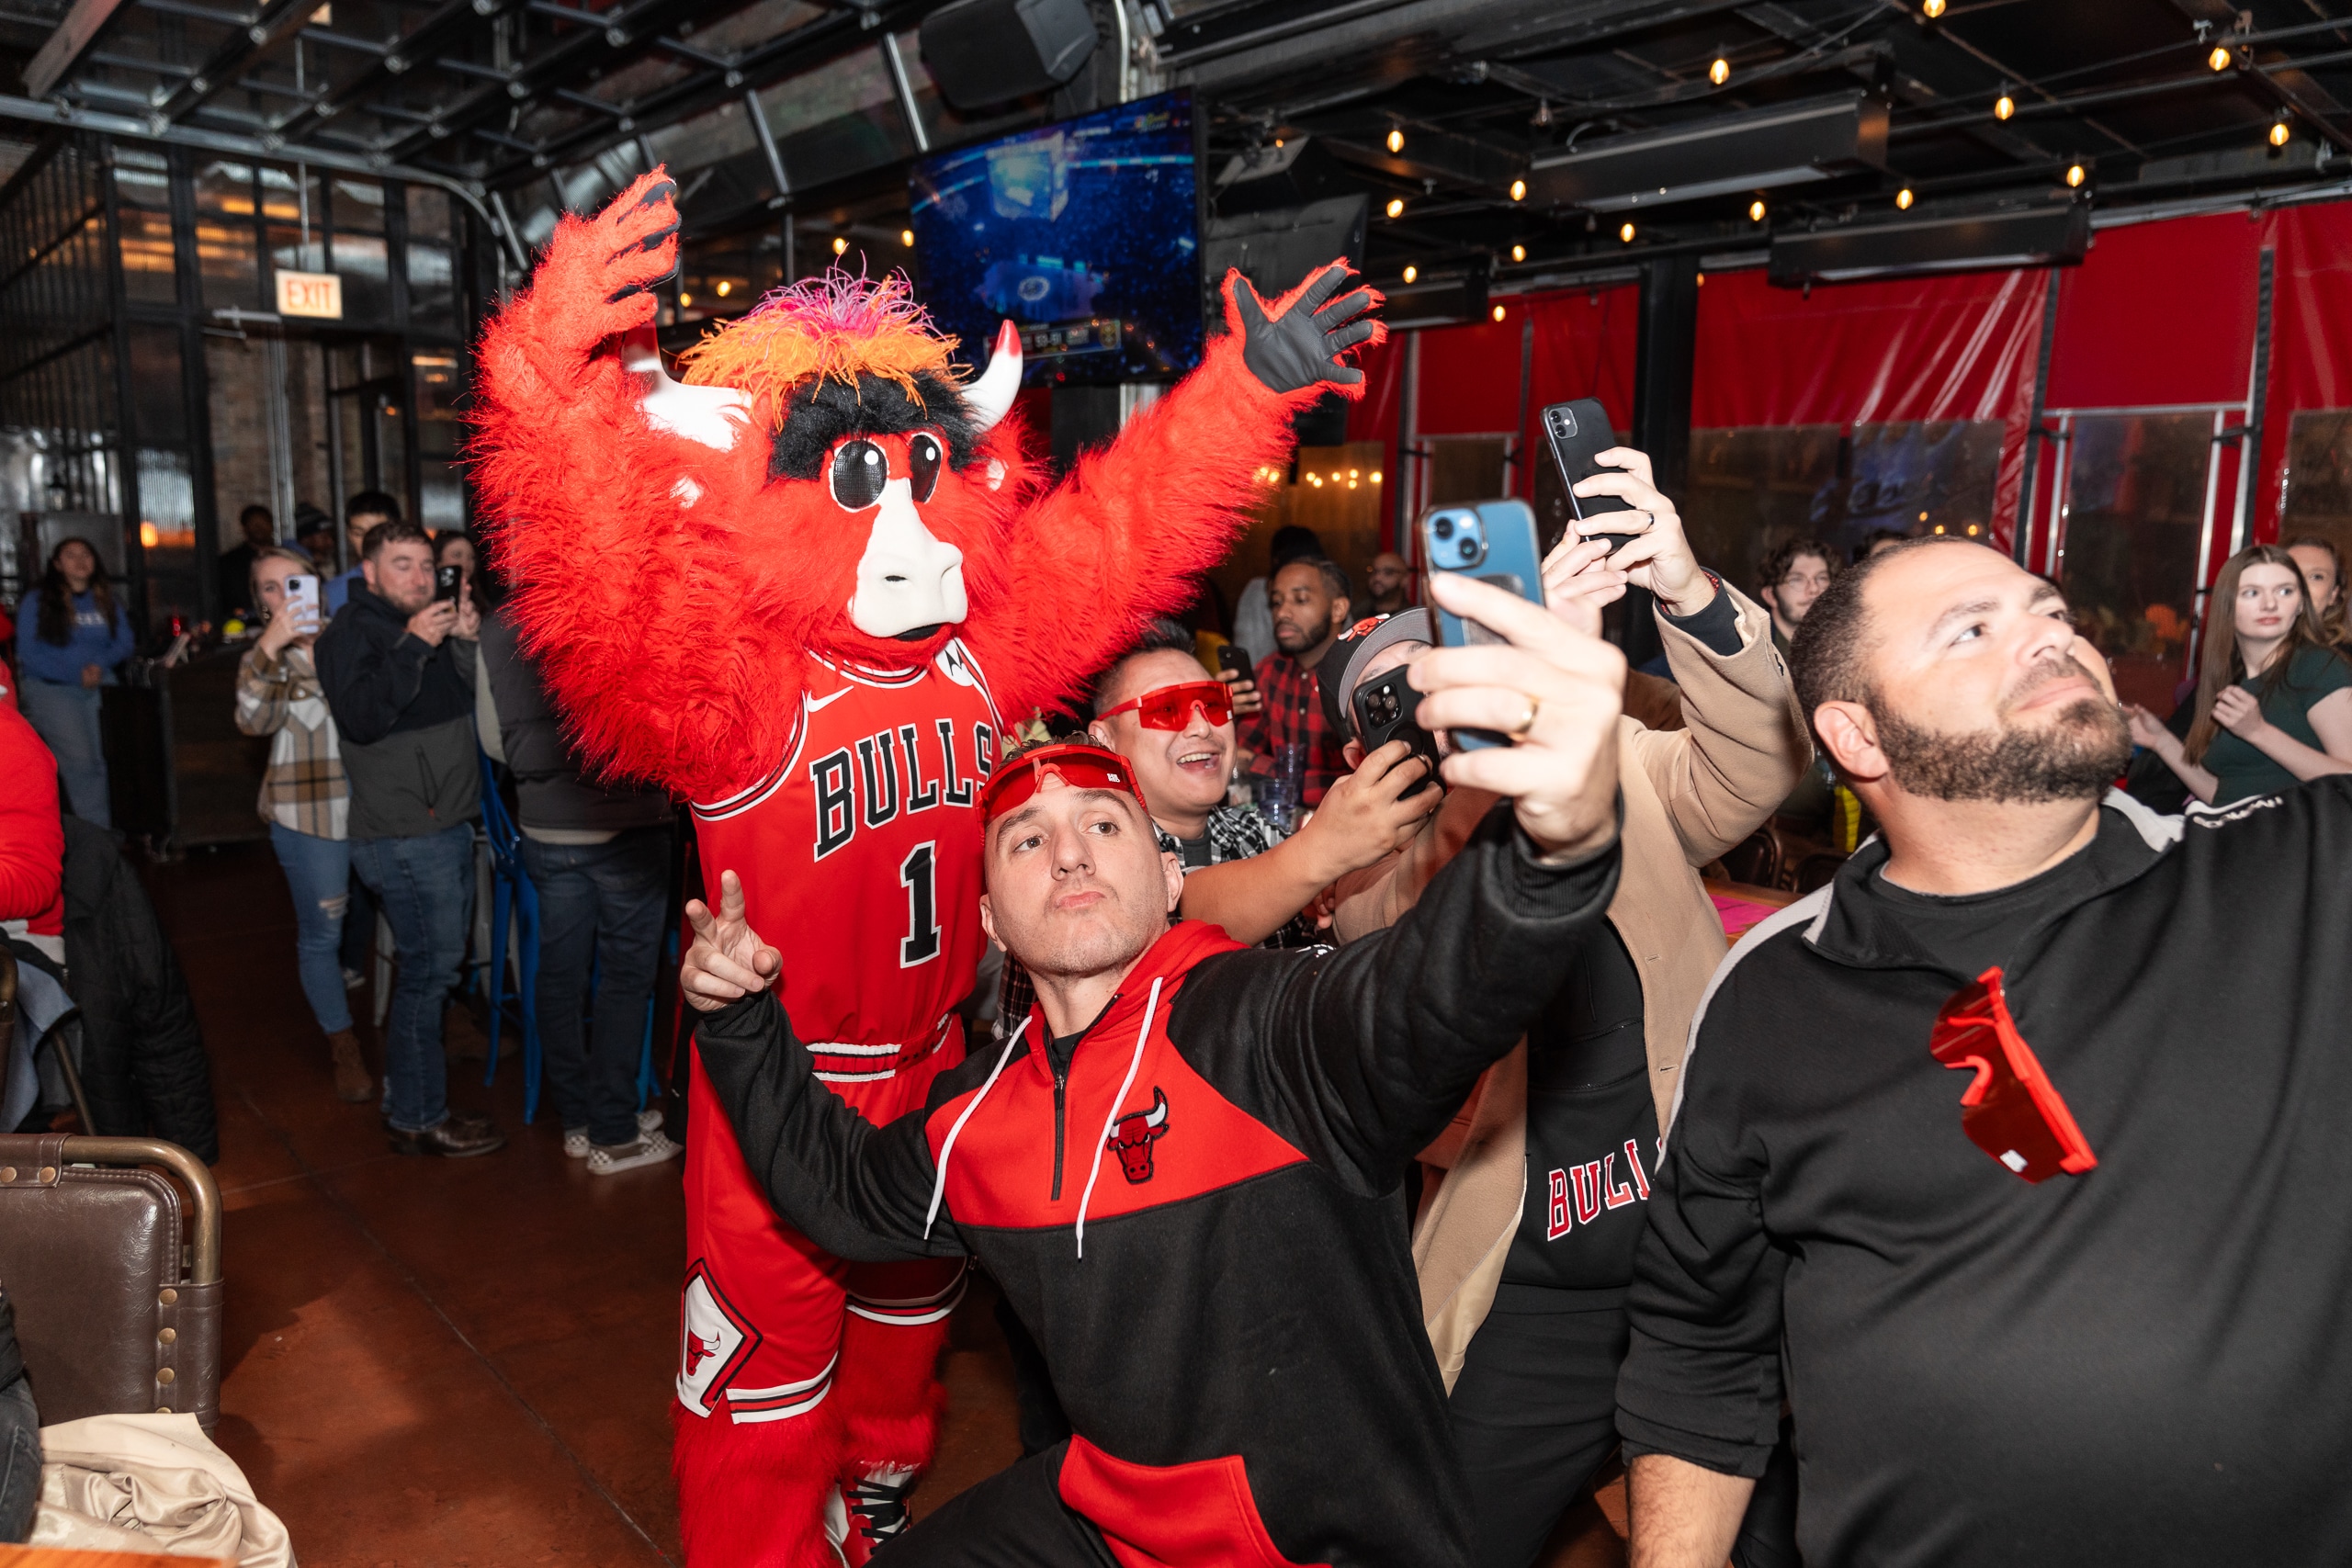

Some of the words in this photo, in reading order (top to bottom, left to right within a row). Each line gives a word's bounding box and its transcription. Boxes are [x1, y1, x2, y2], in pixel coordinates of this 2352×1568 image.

[286, 279, 333, 310] EXIT
[808, 717, 993, 863] BULLS
[899, 840, 942, 969] 1
[1547, 1137, 1662, 1241] BULL
